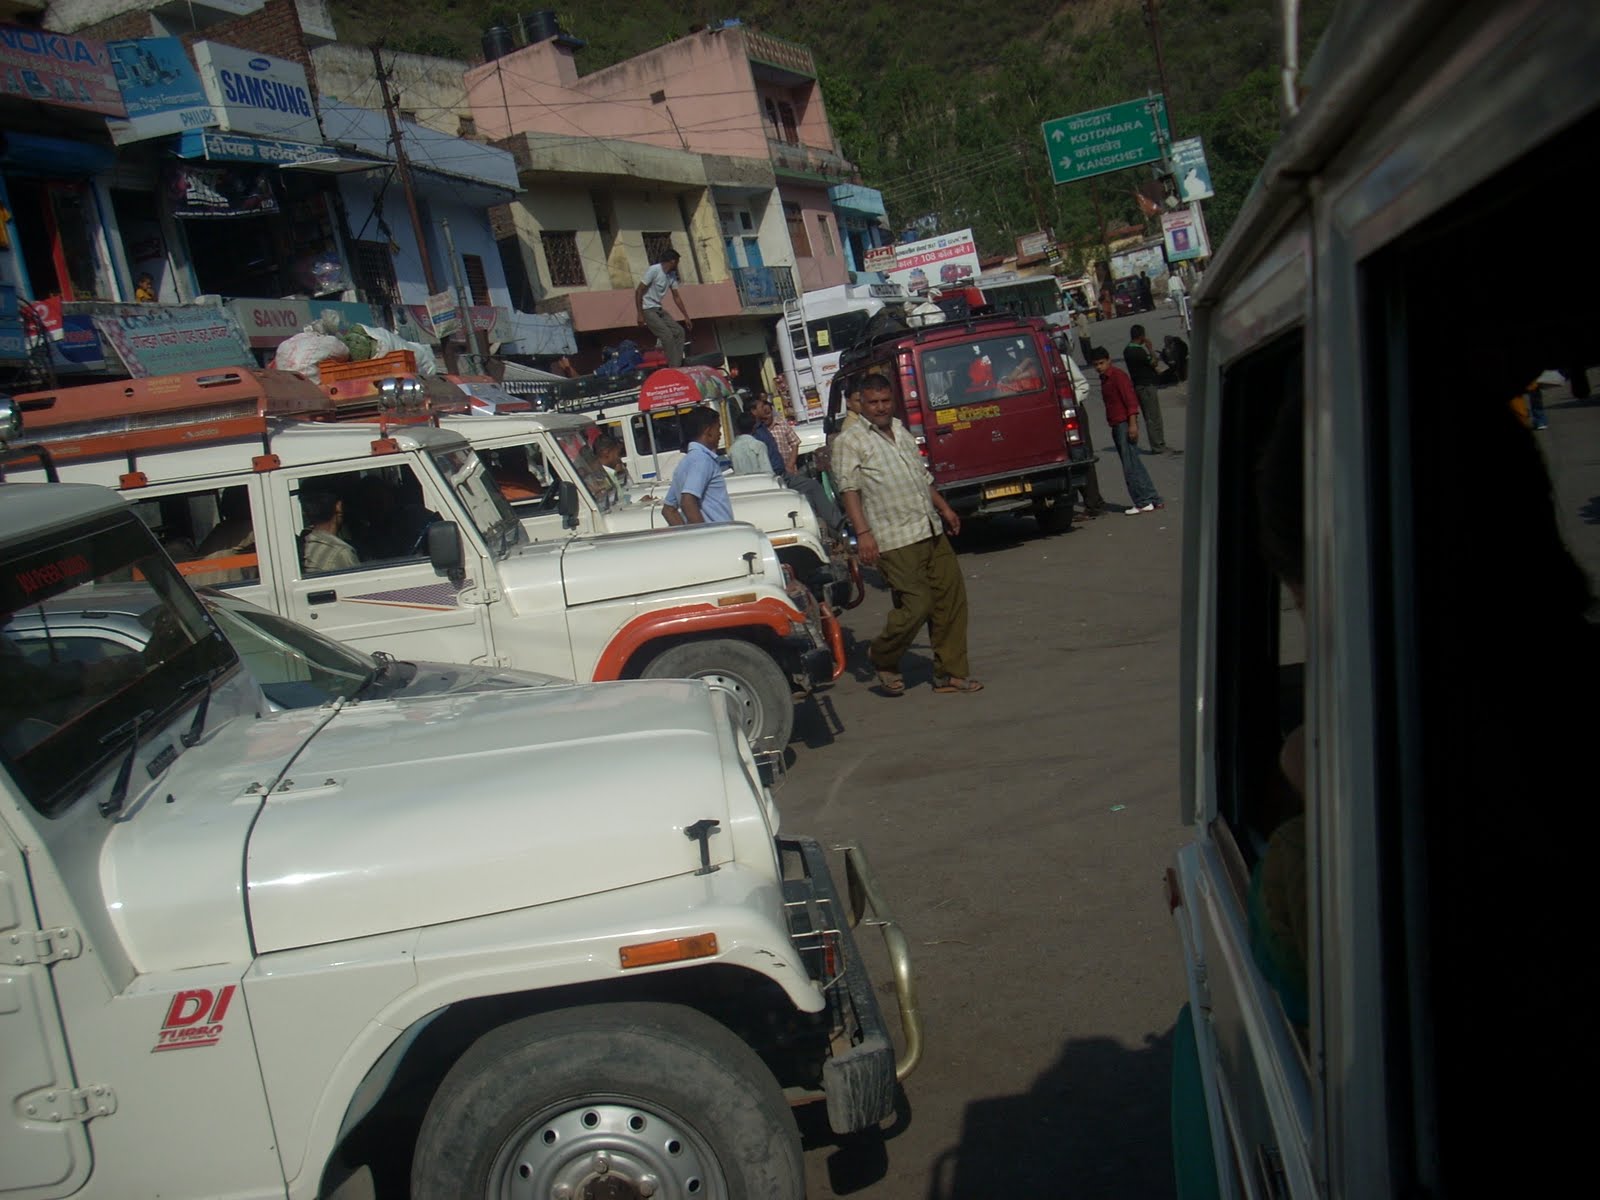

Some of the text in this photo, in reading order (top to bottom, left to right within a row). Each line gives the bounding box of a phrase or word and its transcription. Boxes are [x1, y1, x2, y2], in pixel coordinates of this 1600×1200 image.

[0, 29, 97, 66] NOKIA
[220, 69, 311, 118] SAMSUNG
[180, 108, 216, 127] PHILIPS
[1070, 120, 1144, 145] KOTDWARA
[1076, 147, 1144, 172] KANSKHET
[921, 252, 936, 263] 108
[253, 309, 298, 327] SANYO
[161, 985, 236, 1029] DI
[159, 1024, 224, 1043] TURBO
